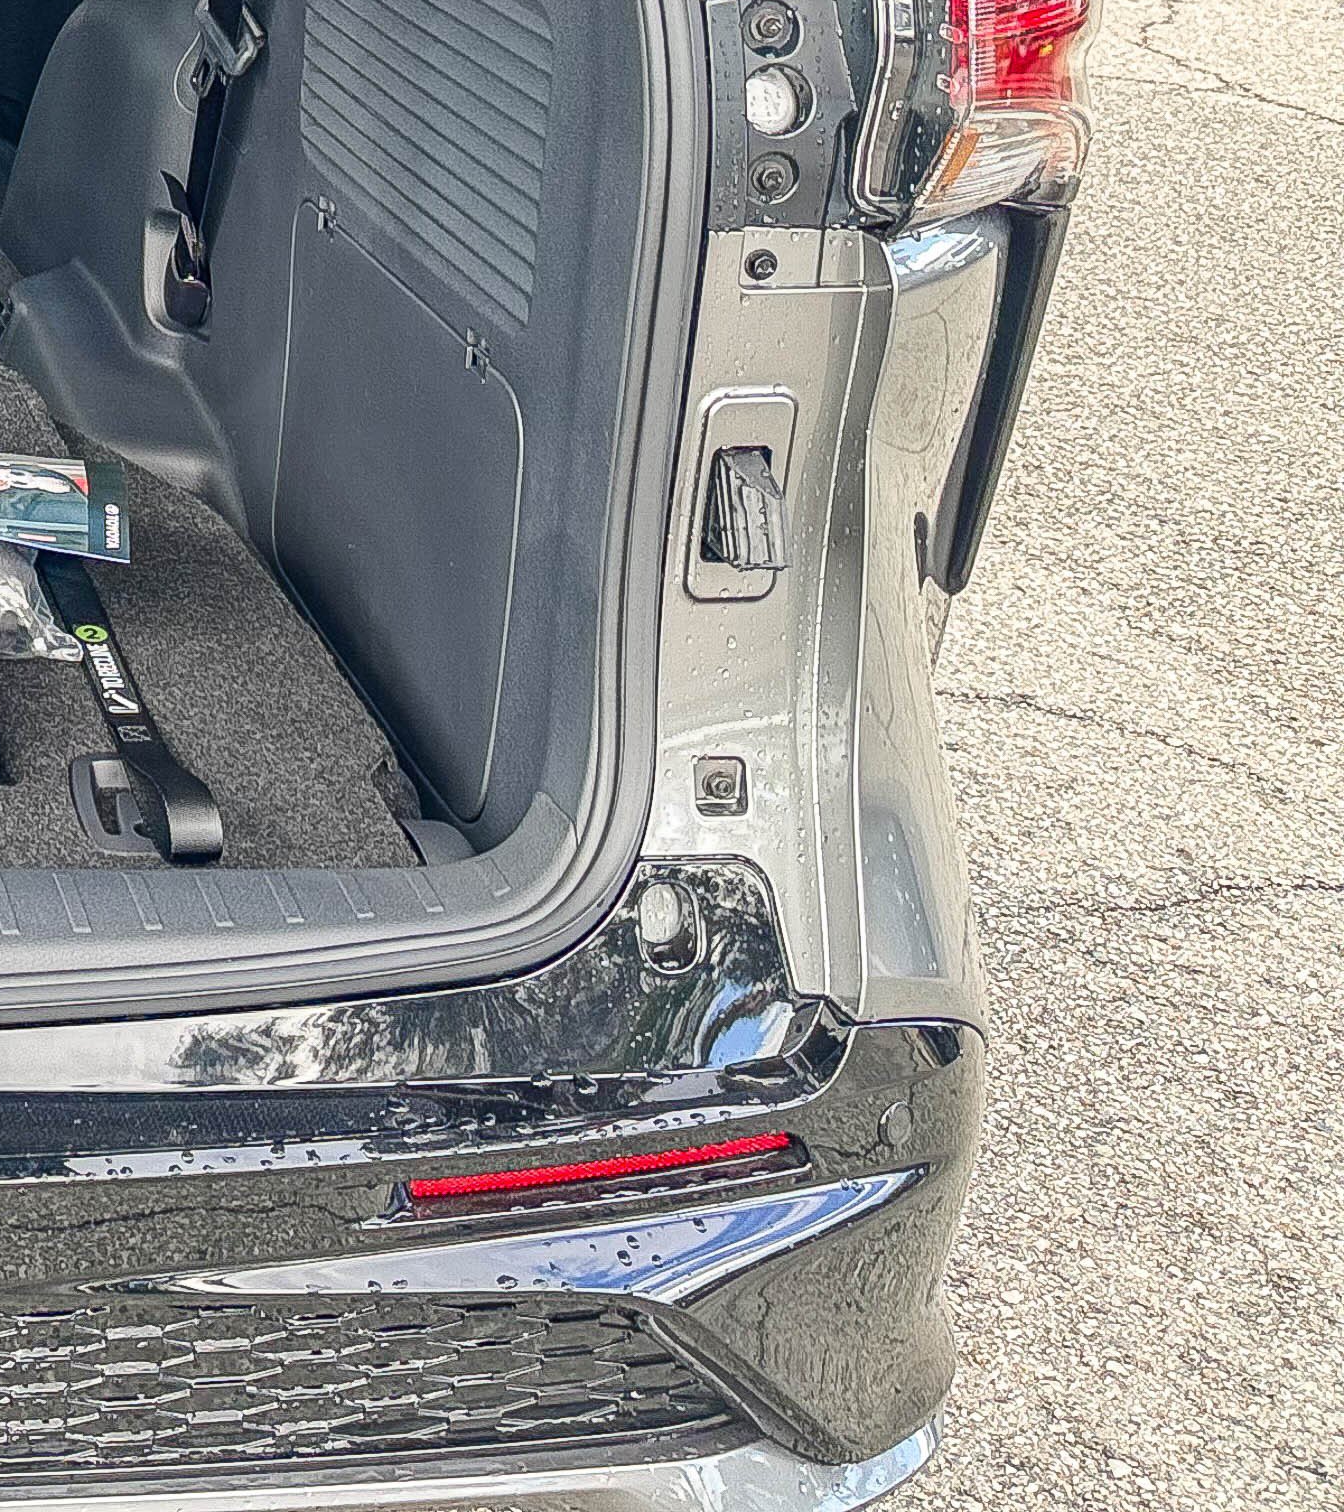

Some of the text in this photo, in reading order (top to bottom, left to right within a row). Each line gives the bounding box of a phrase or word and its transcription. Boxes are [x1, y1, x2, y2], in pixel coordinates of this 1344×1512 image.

[83, 627, 101, 640] 2
[85, 643, 125, 690] TO RECLINE
